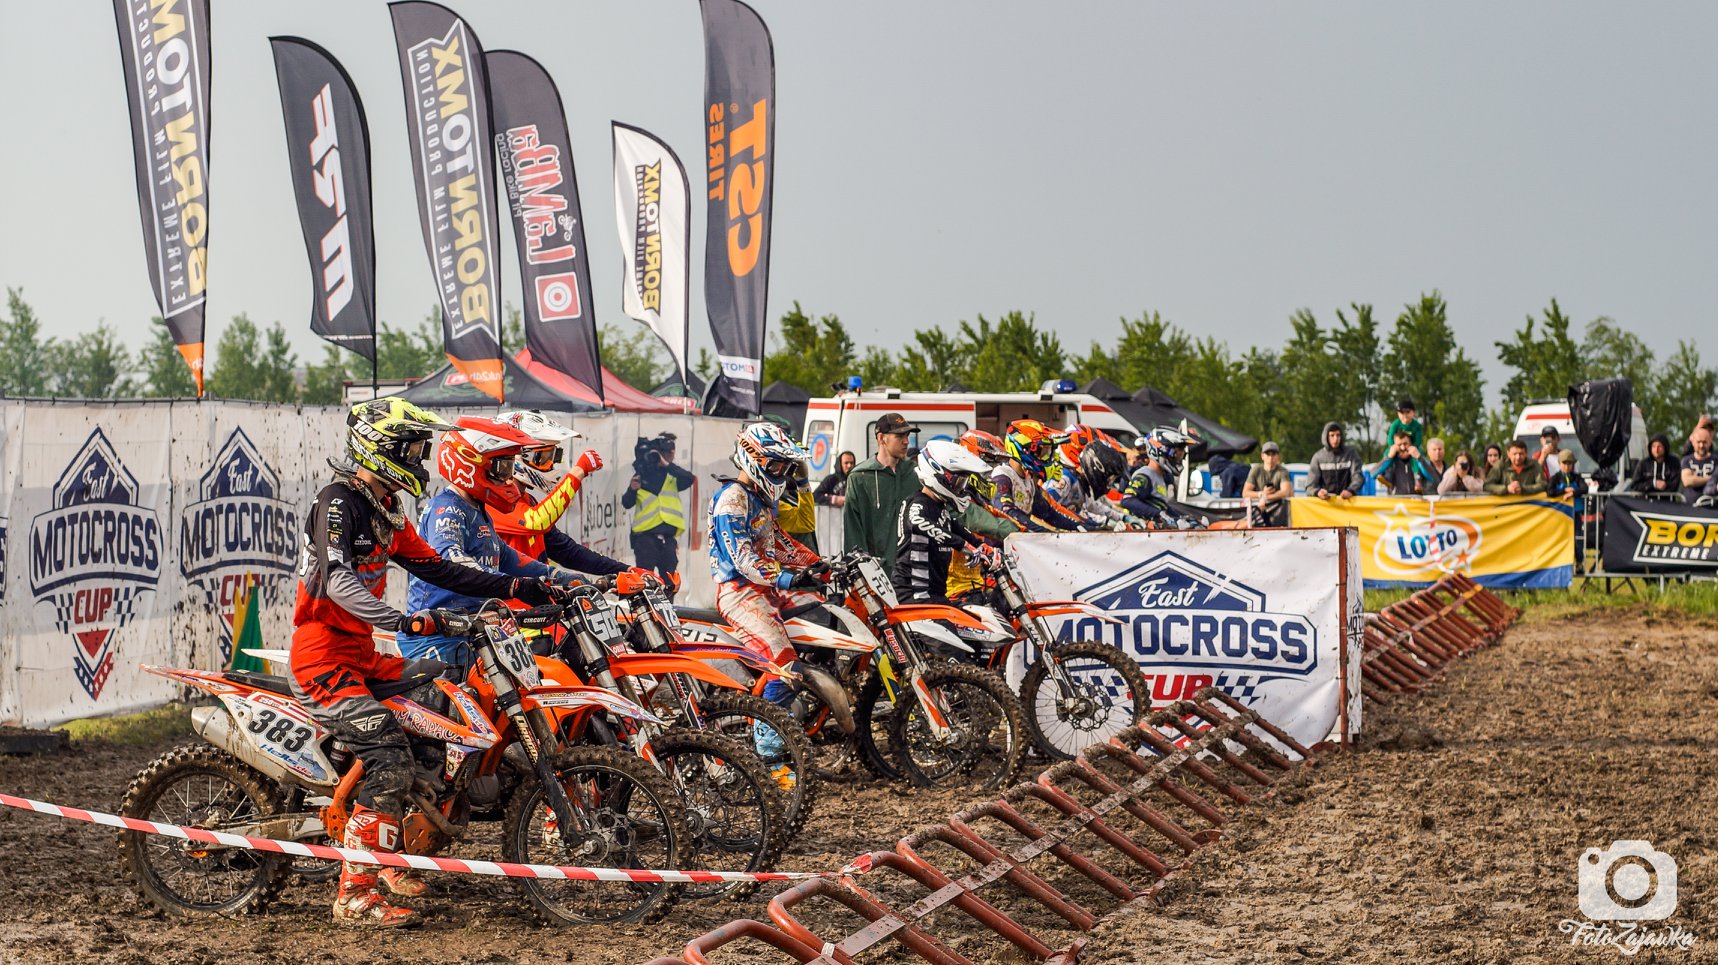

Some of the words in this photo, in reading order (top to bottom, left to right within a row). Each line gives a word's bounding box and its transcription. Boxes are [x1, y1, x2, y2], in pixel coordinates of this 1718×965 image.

[353, 420, 398, 450] 100%
[82, 461, 111, 502] East
[227, 457, 253, 494] East
[33, 510, 159, 581] MOTOCROSS
[181, 502, 296, 566] MOTOCROSS
[1396, 529, 1458, 559] LOTO
[1642, 544, 1710, 560] EXTREME
[74, 587, 112, 625] CUP
[1138, 577, 1199, 608] East
[248, 709, 313, 753] 383
